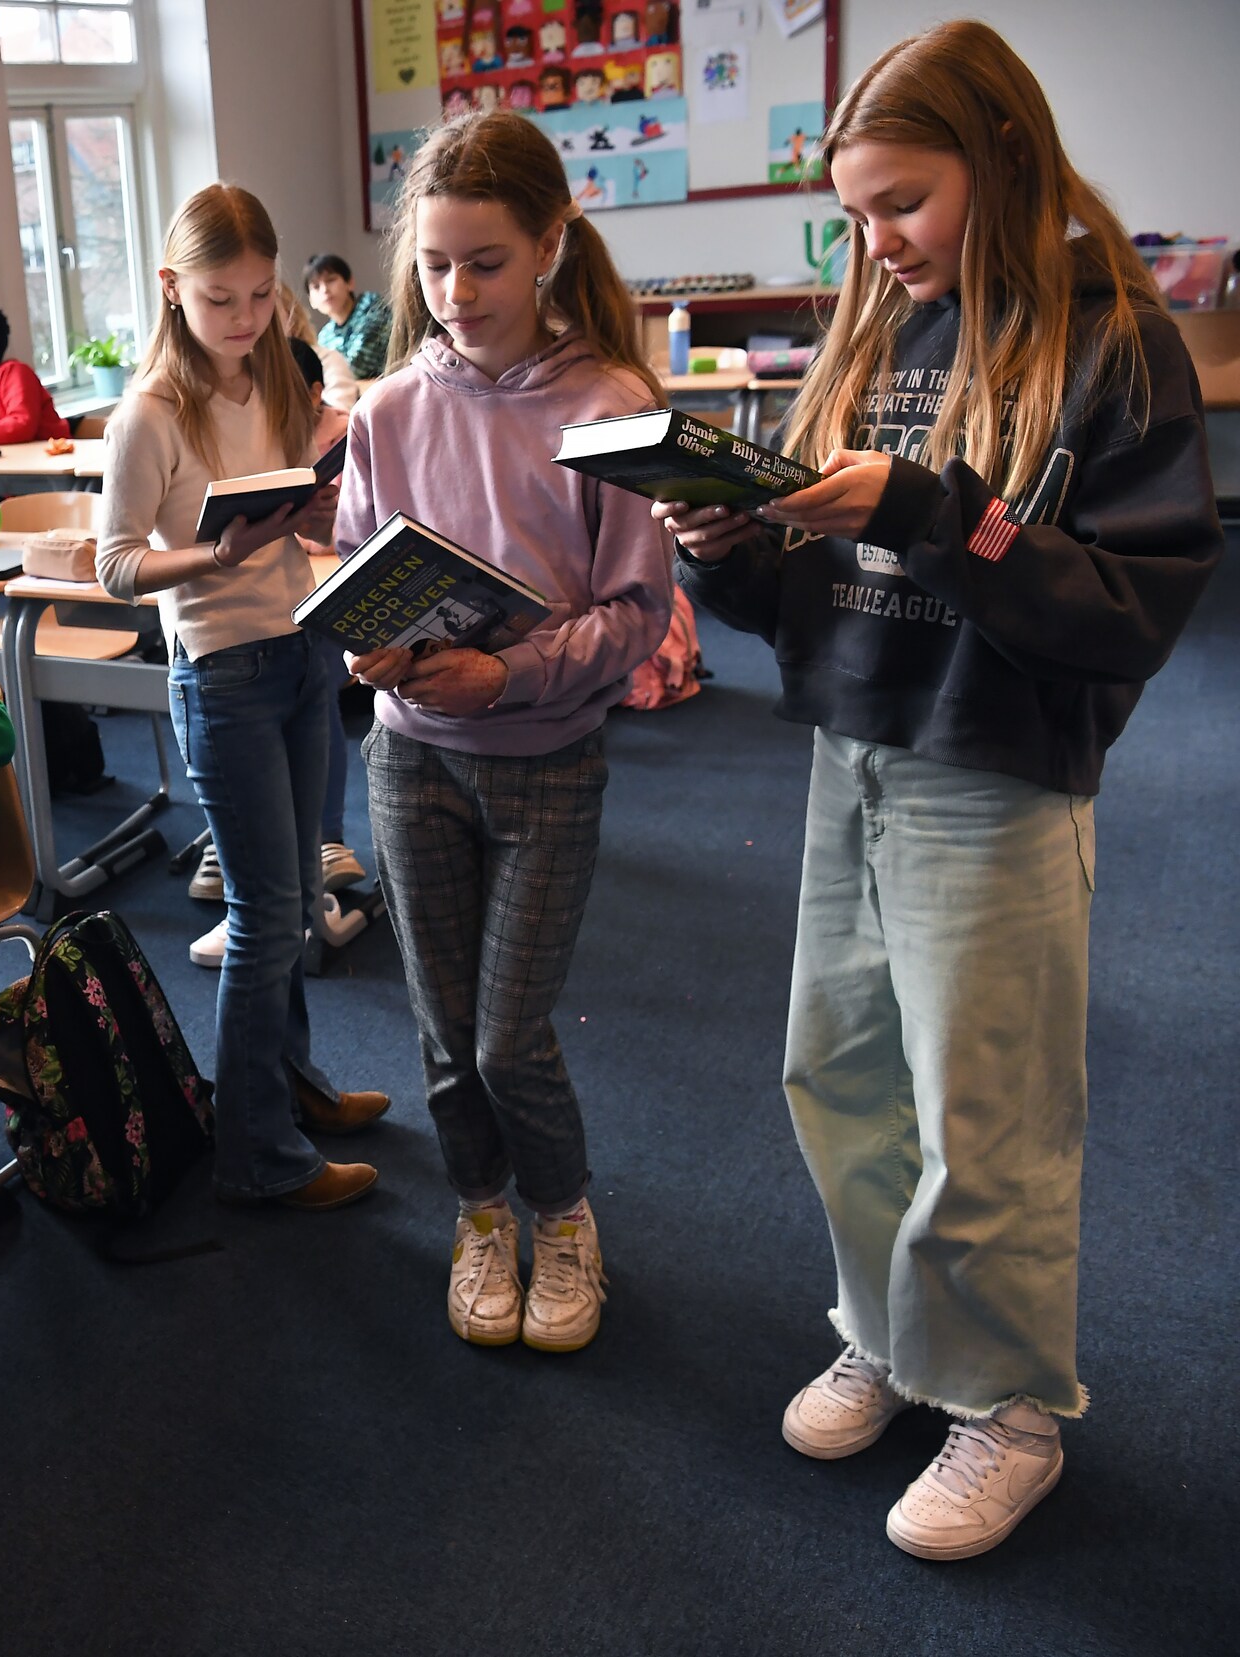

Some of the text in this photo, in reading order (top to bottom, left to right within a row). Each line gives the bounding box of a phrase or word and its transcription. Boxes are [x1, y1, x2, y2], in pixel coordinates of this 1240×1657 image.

[906, 368, 925, 389] IN
[676, 433, 715, 458] Oliver
[682, 419, 719, 443] Jamie
[731, 441, 761, 466] Billy
[772, 456, 806, 485] REUZEN
[744, 465, 786, 486] avontuur
[332, 556, 424, 633] REKENEN
[348, 597, 403, 641] VOOR
[368, 628, 394, 651] JE
[391, 574, 457, 629] LEVEN
